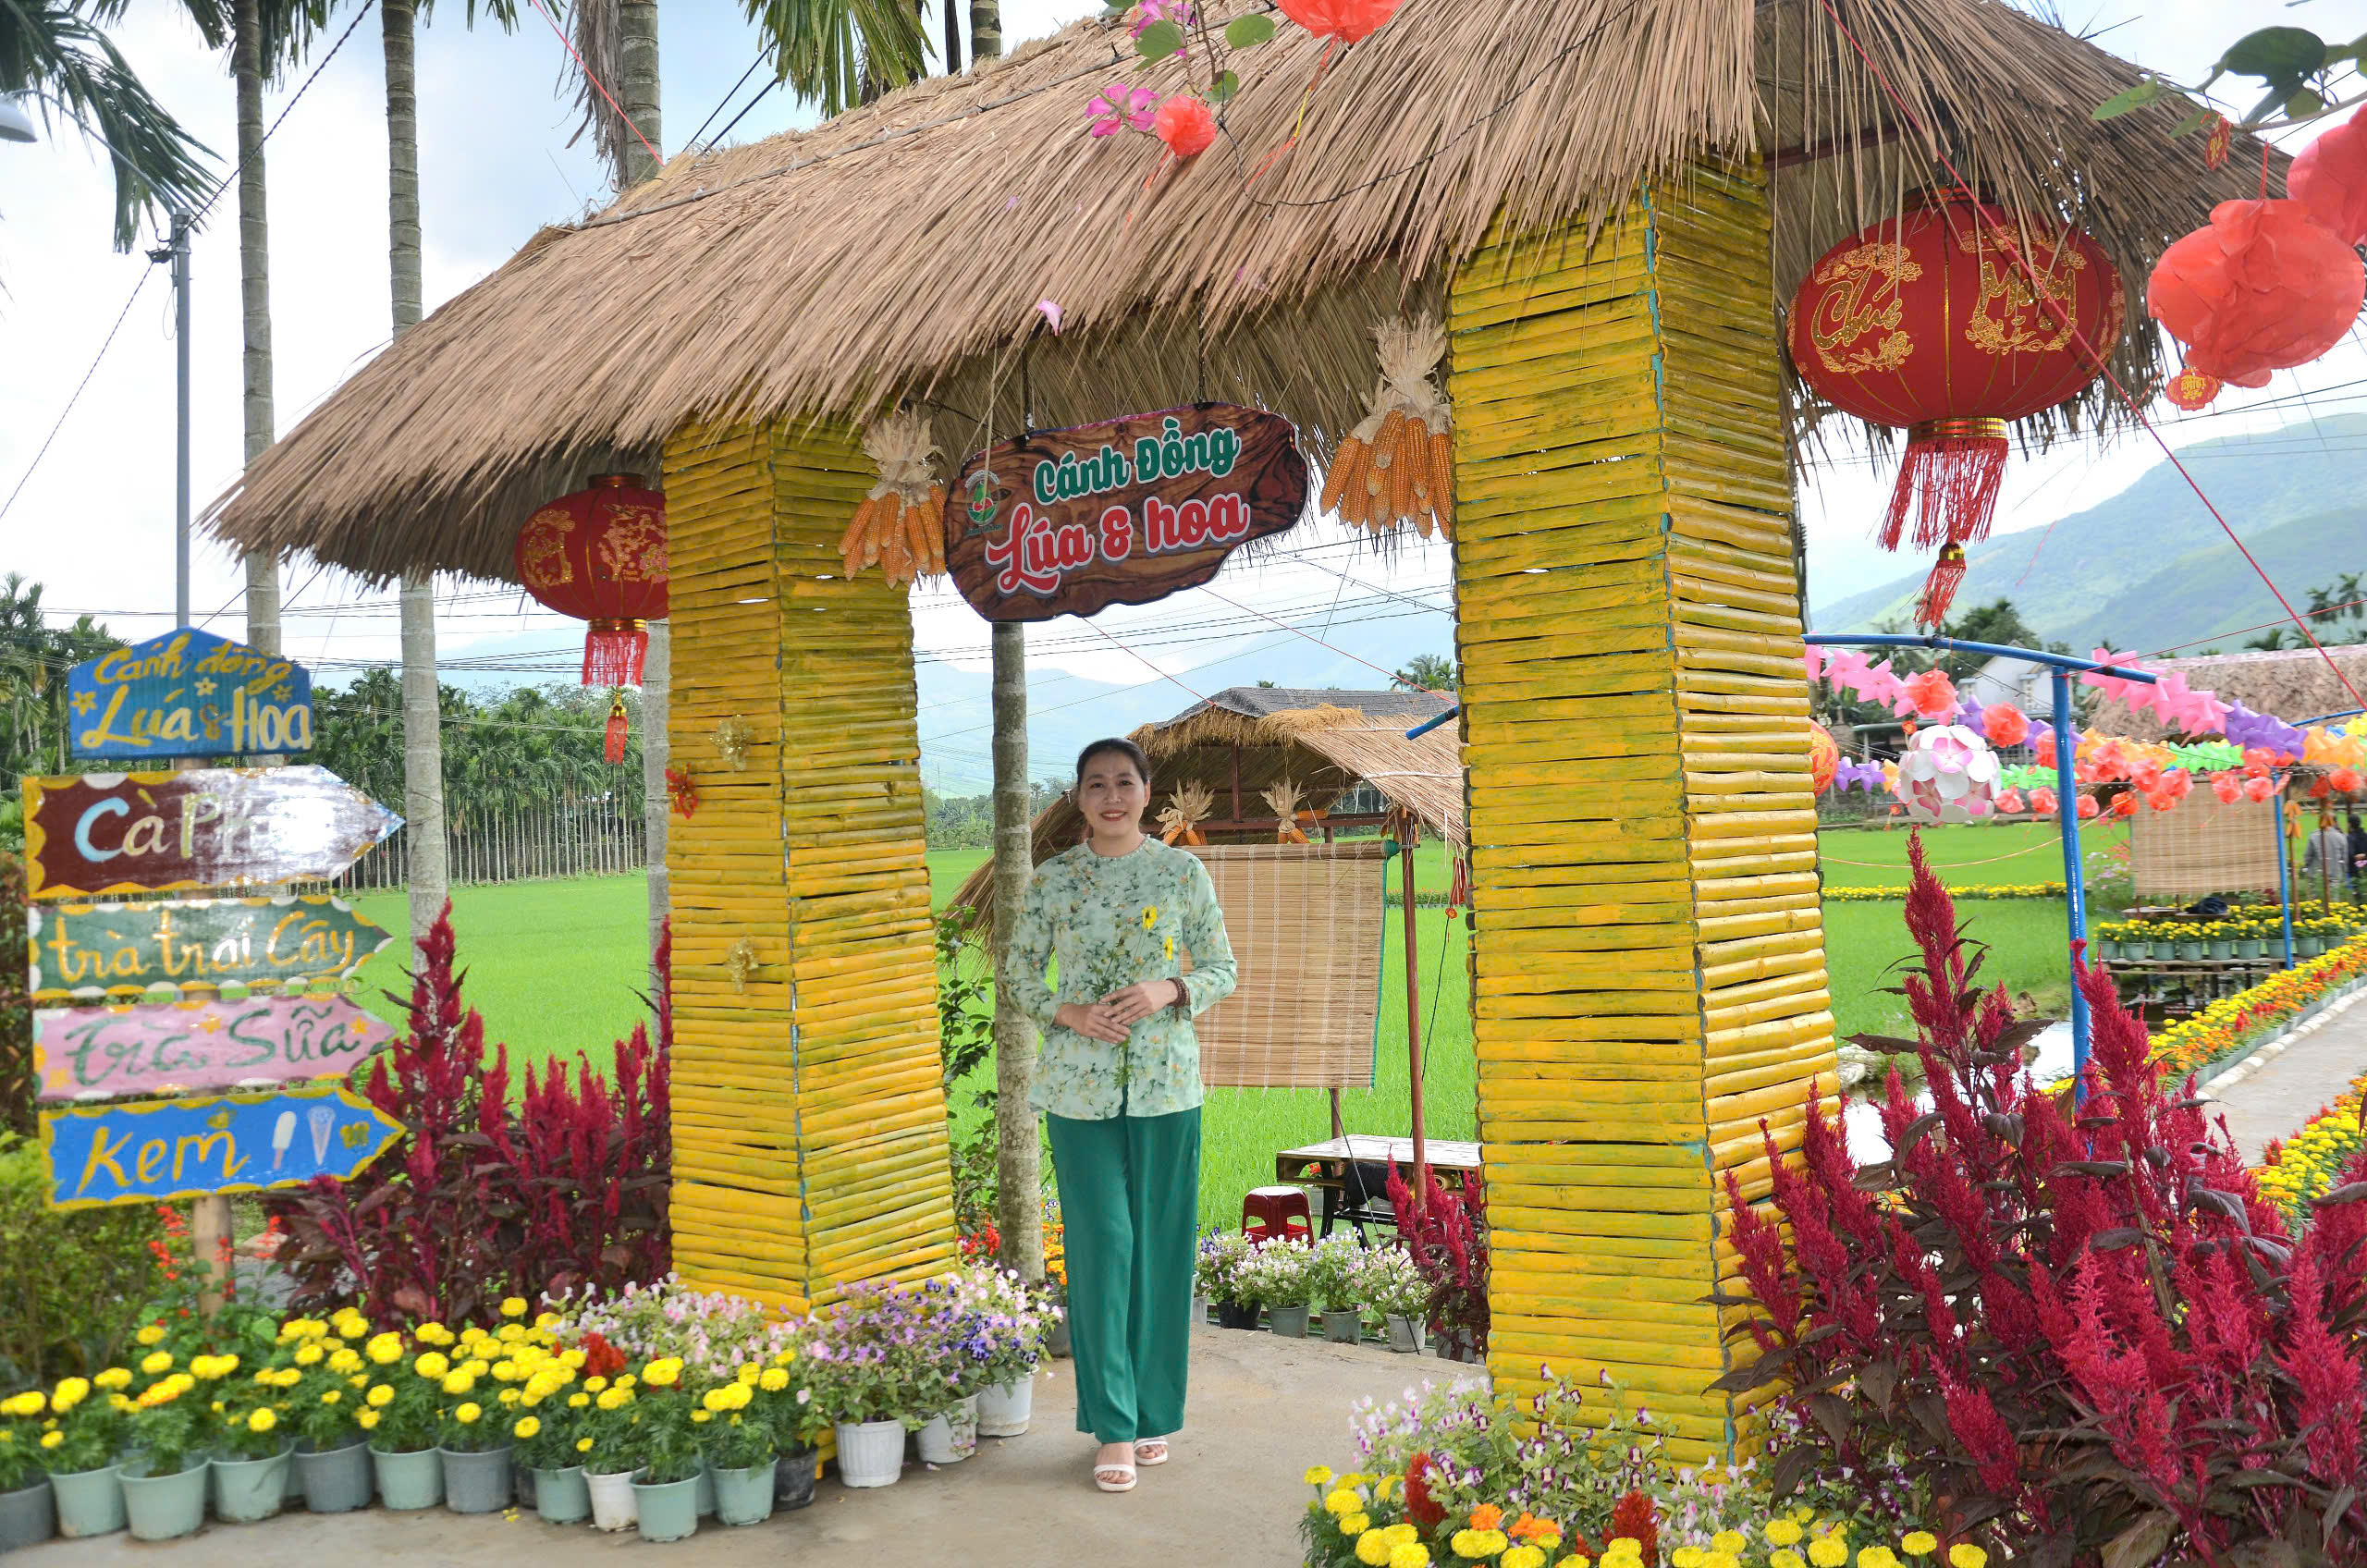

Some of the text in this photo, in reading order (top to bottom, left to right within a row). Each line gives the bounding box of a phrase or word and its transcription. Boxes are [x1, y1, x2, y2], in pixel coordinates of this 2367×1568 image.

[1810, 265, 1903, 349] Chúc
[1033, 416, 1242, 506] Cánh Đồng
[985, 493, 1251, 596] Lúa & hoa
[80, 685, 199, 749] Lúa
[225, 686, 315, 753] Hoa
[75, 788, 171, 862] Cà
[46, 916, 152, 983] trà
[226, 1006, 361, 1068] Sữa
[76, 1125, 251, 1195] Kem
